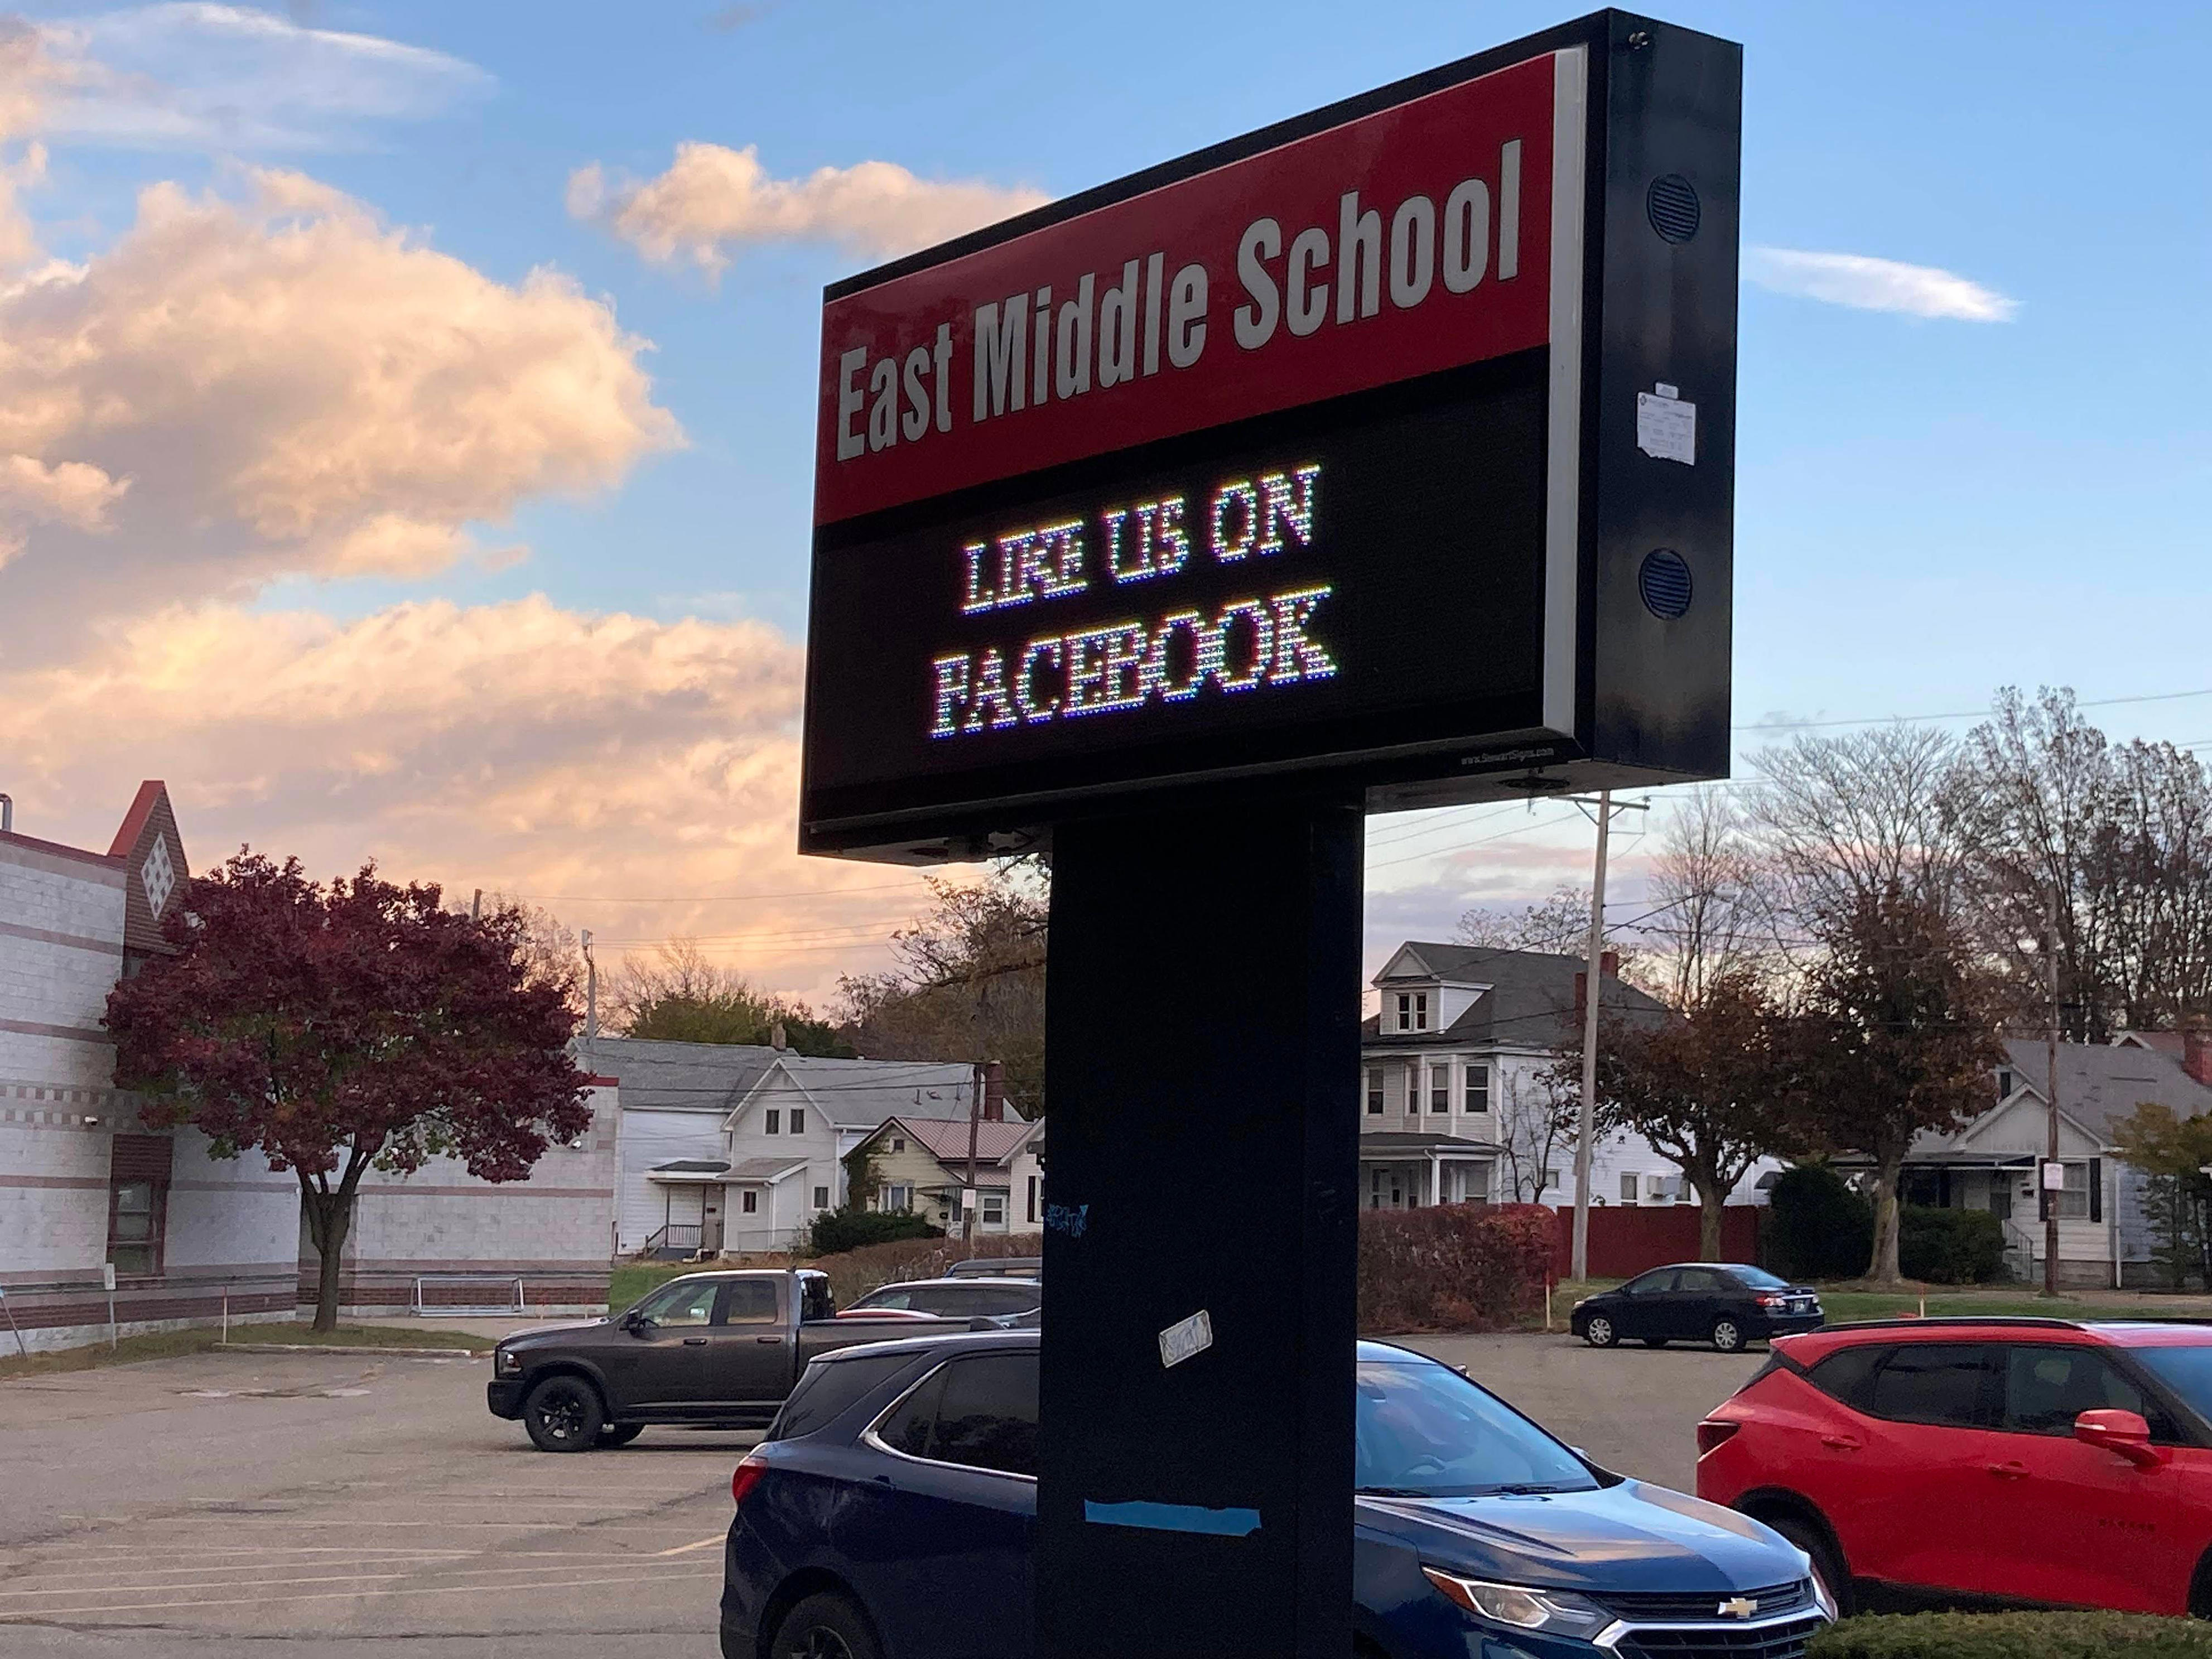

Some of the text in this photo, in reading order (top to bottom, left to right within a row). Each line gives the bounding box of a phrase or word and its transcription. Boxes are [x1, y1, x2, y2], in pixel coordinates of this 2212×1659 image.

[837, 138, 1521, 462] East Middle School
[961, 464, 1320, 615] LIKE US ON
[929, 586, 1338, 739] FACEBOOK
